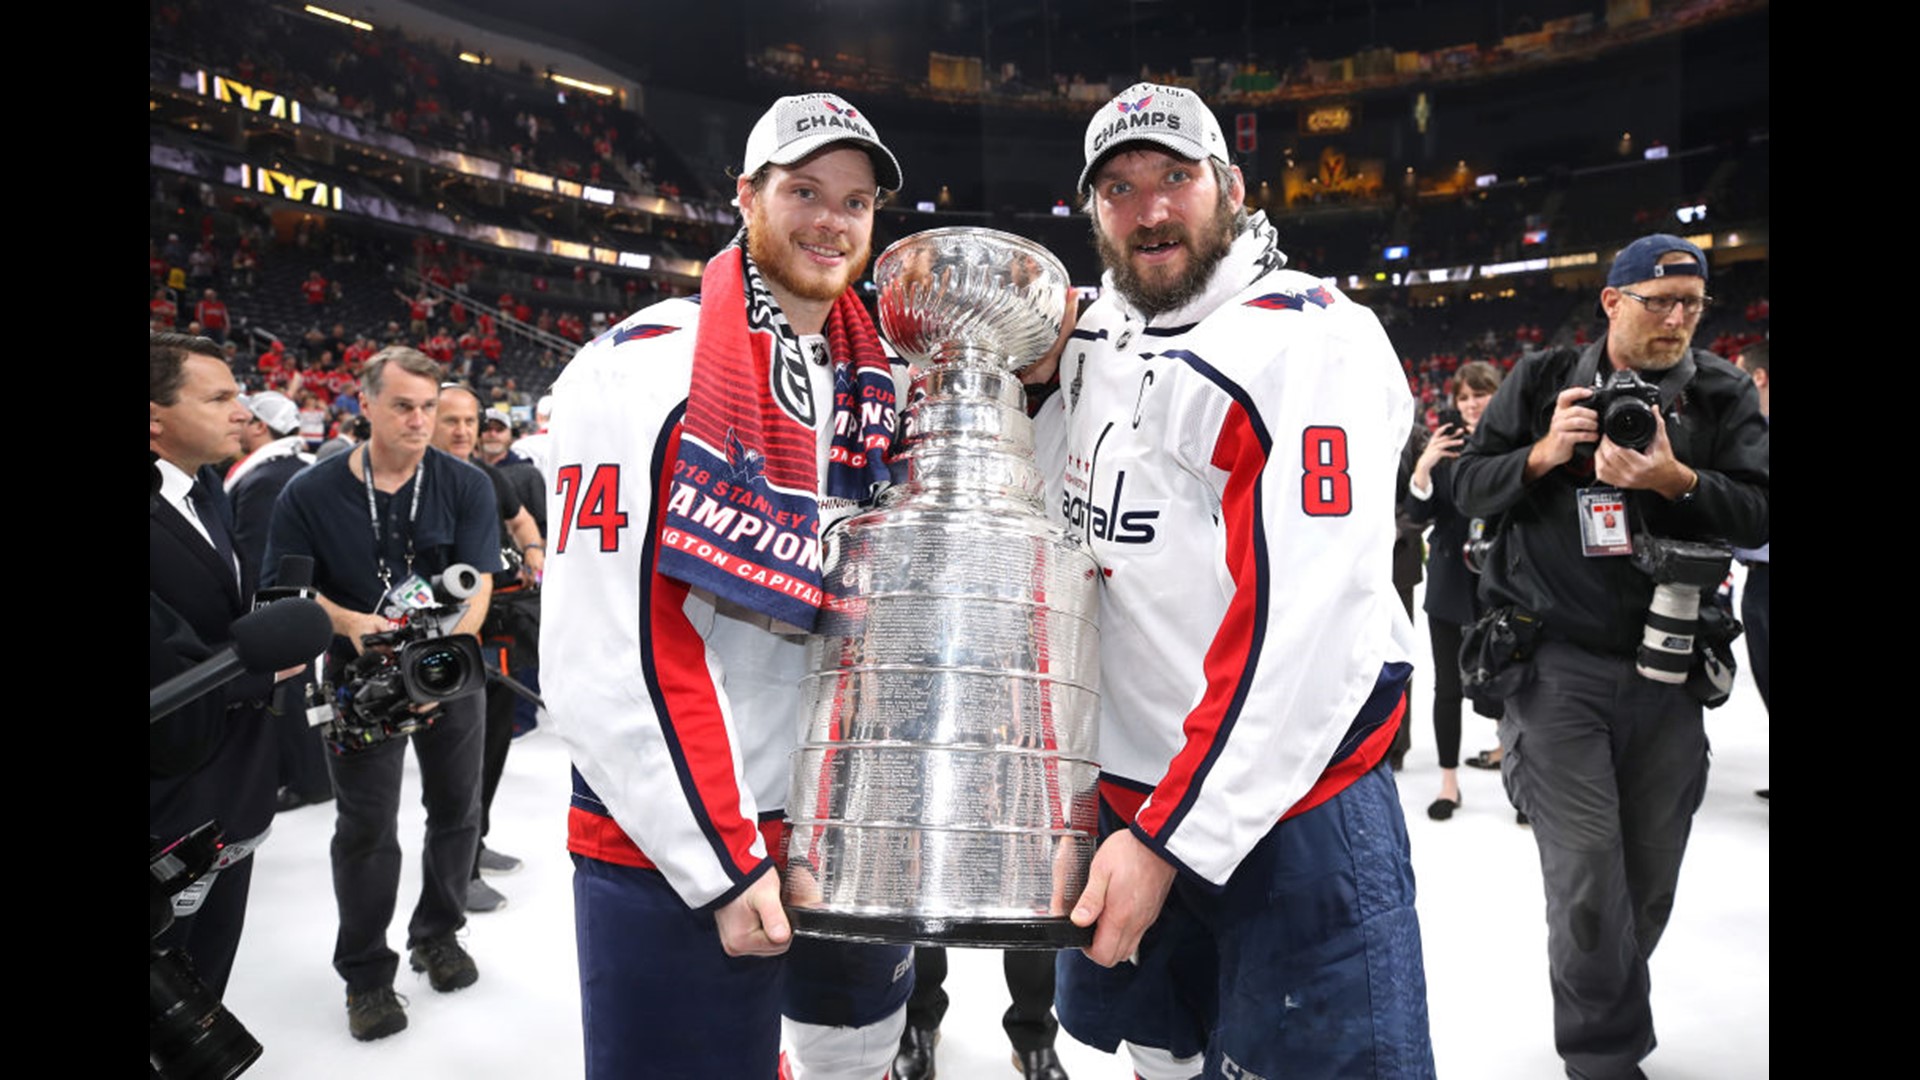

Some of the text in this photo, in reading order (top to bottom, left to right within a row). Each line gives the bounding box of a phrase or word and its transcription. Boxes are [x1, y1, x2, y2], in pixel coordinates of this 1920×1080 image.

[1094, 112, 1181, 151] CHAMPS
[1133, 369, 1155, 430] C
[1301, 425, 1352, 517] 8
[556, 463, 629, 554] 74
[667, 481, 820, 572] AMPION
[712, 480, 807, 530] STANLEY
[736, 563, 823, 606] CAPITAL
